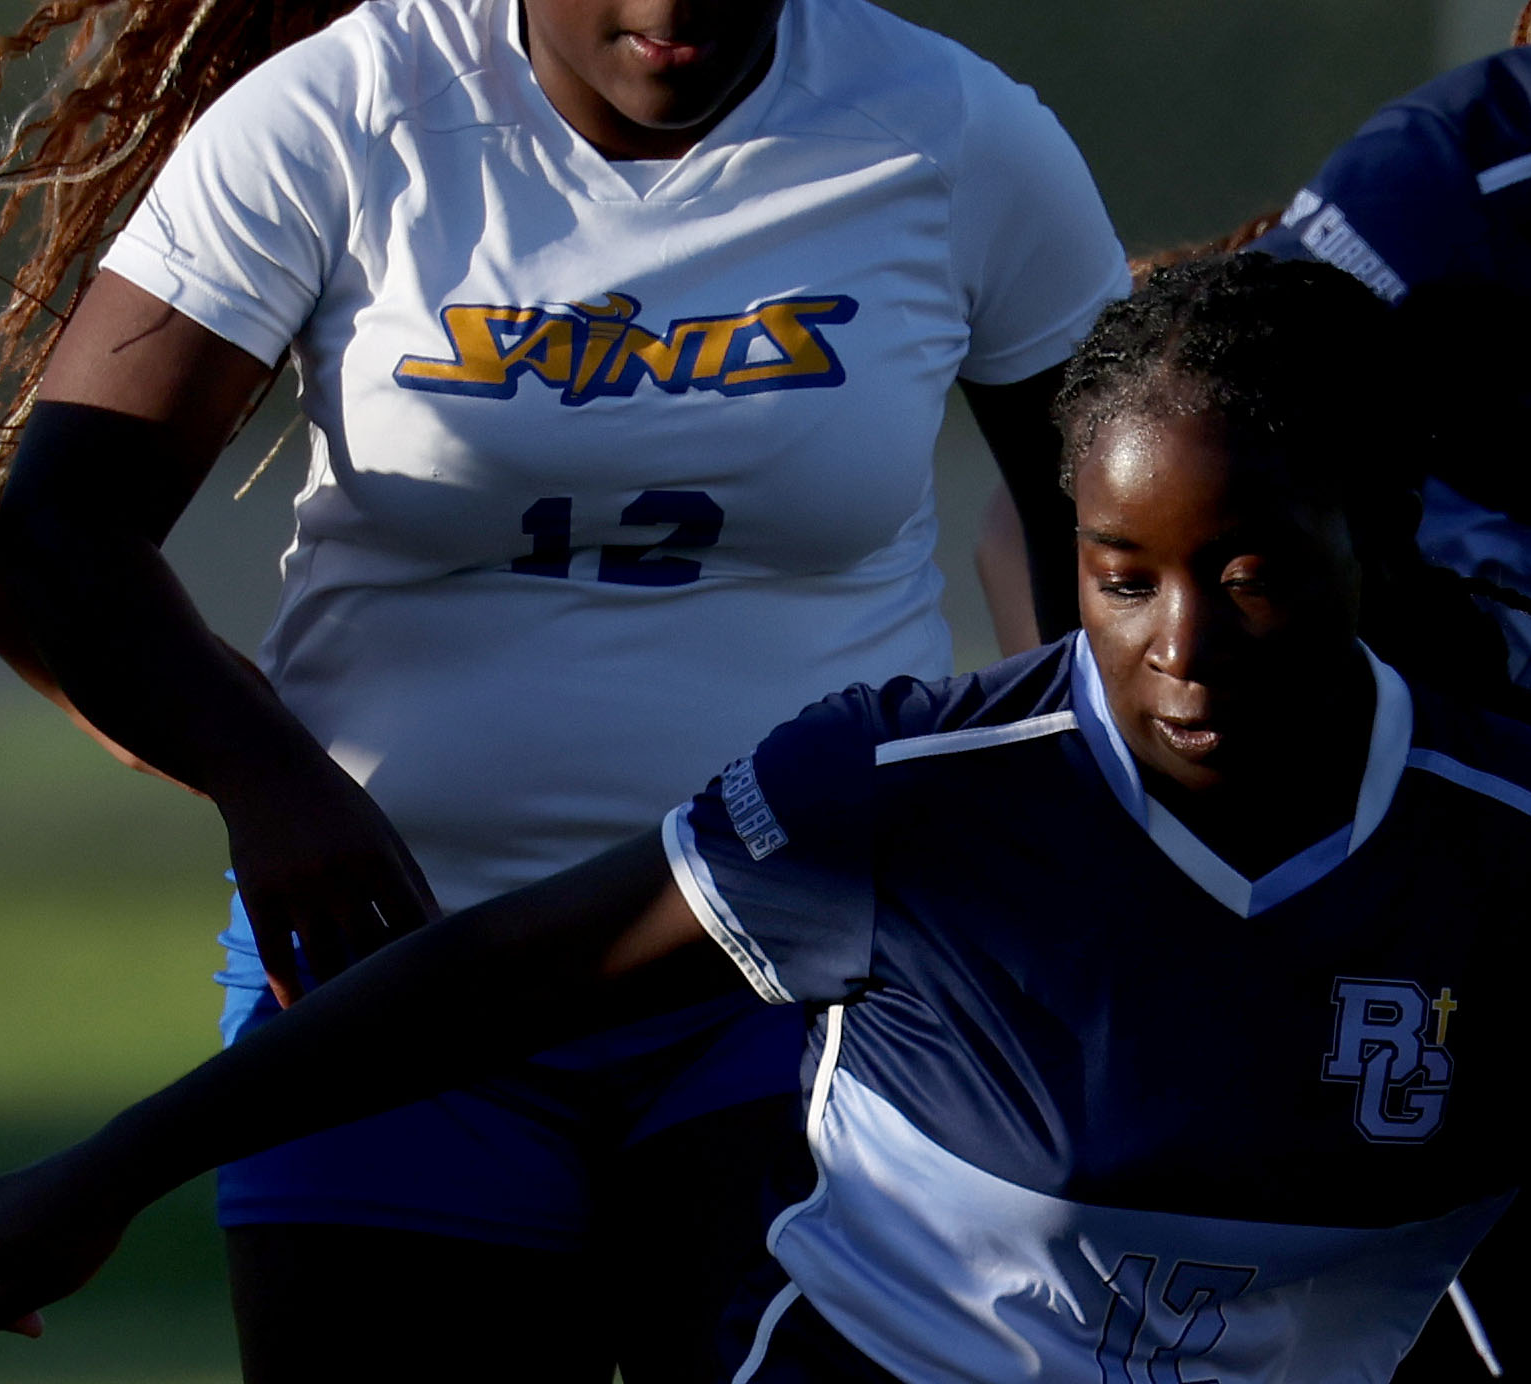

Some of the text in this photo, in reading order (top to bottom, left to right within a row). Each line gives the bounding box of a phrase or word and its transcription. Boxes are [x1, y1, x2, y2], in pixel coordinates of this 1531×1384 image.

[393, 291, 859, 407] SAINTS
[511, 490, 725, 587] 12
[1321, 976, 1455, 1144] BG
